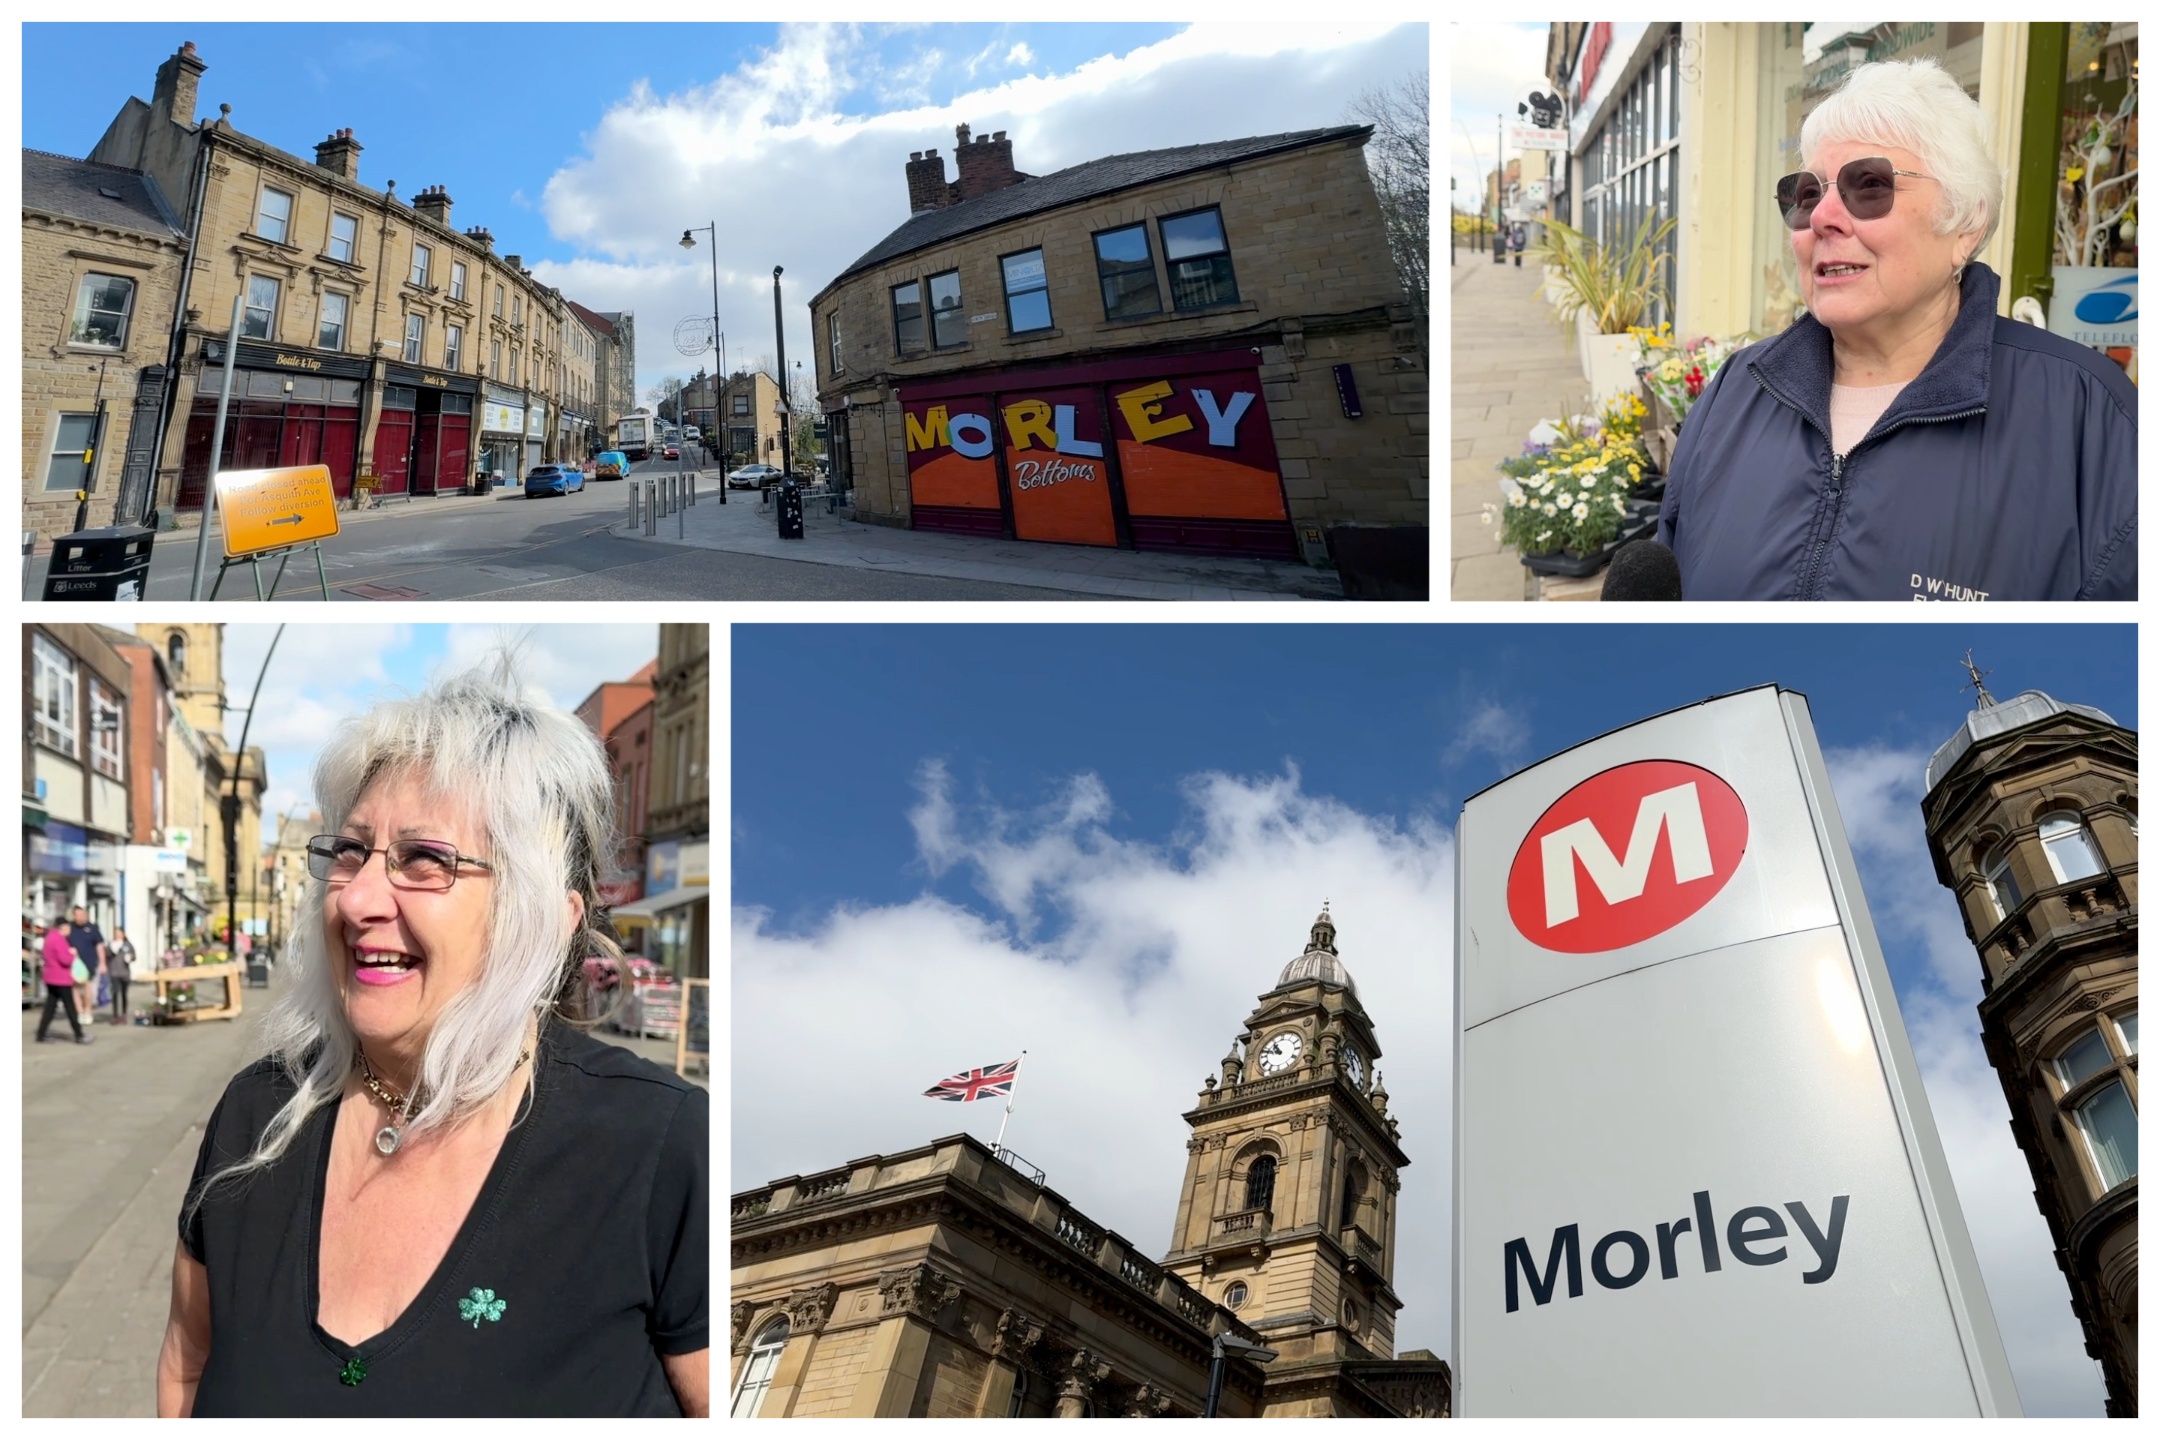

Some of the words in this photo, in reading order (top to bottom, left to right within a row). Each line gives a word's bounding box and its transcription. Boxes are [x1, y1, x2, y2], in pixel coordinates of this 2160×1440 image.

[276, 353, 300, 366] Bottle
[307, 357, 321, 371] Tap
[903, 379, 1256, 457] MORLEY
[261, 479, 295, 492] closed
[298, 475, 326, 486] ahead
[1015, 459, 1095, 490] Bottoms
[262, 489, 301, 503] Asquith
[304, 487, 320, 496] Ave
[240, 505, 277, 517] Follow
[280, 498, 324, 512] diversion
[68, 564, 92, 572] Litter
[68, 581, 97, 589] Leeds
[1910, 573, 1922, 588] D
[1927, 577, 1942, 594] W
[1944, 582, 1989, 602] HUNT
[1503, 1190, 1850, 1314] Morley
